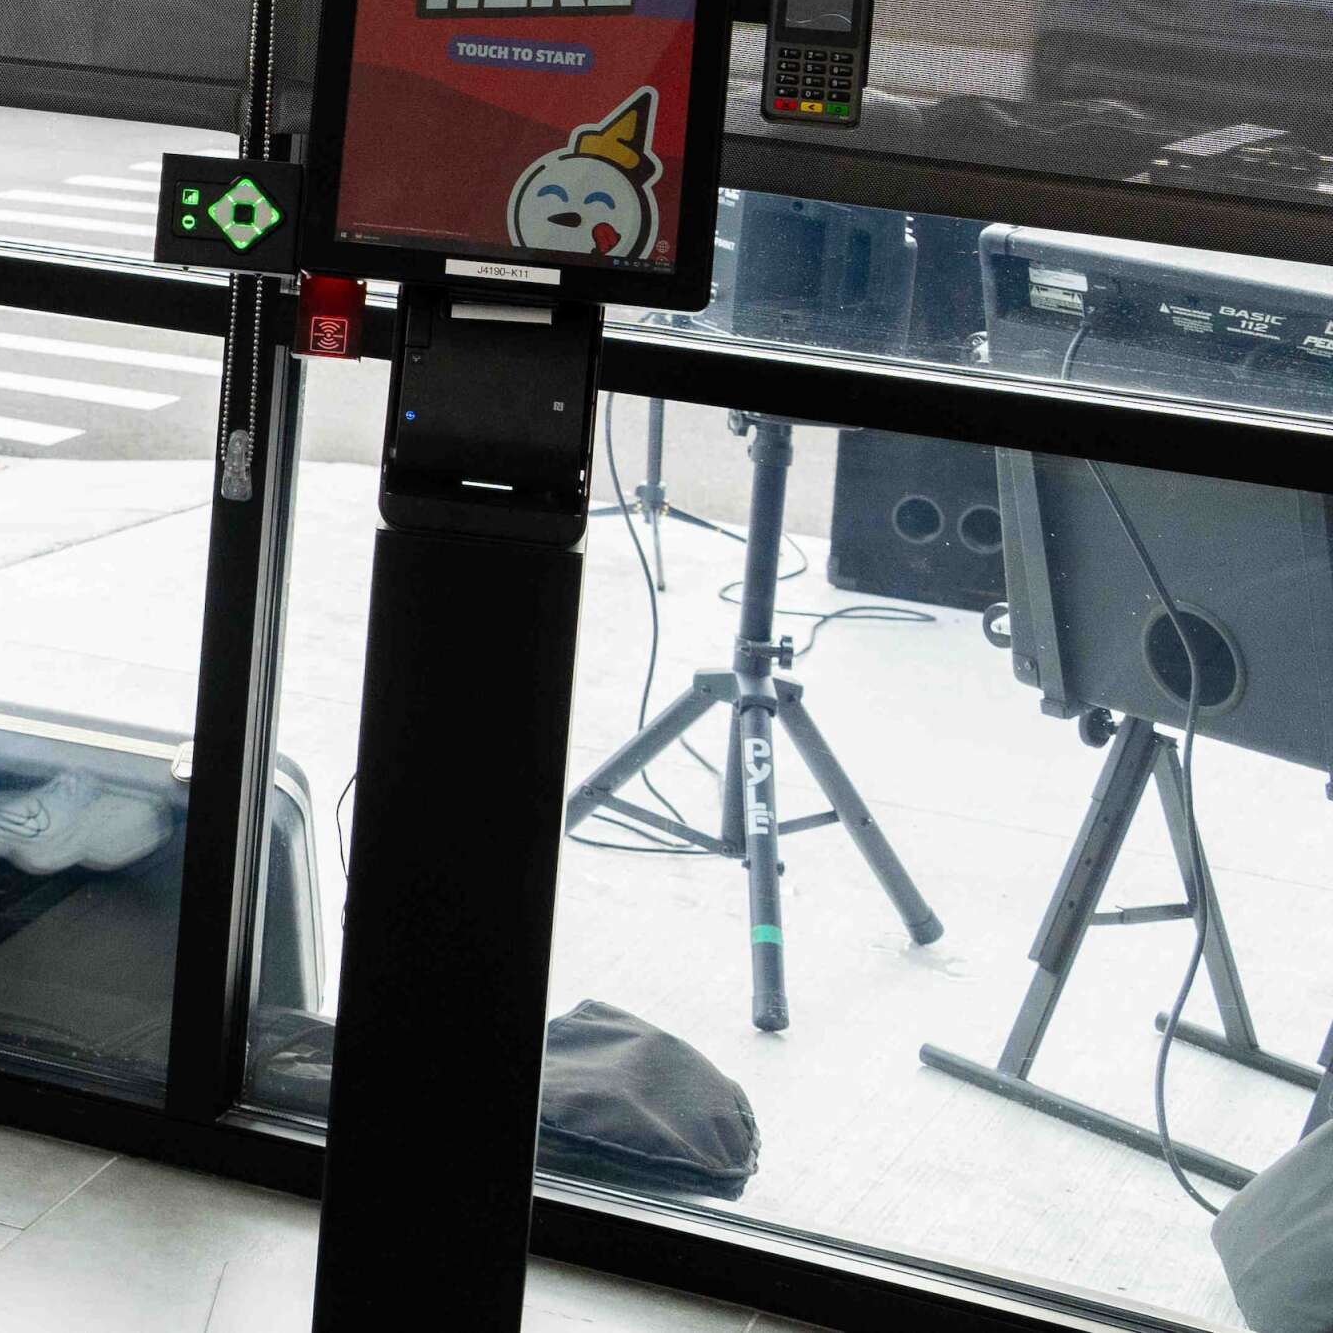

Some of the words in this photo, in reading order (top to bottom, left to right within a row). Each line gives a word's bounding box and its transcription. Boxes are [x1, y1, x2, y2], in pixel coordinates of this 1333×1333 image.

[457, 42, 509, 59] TOUCH
[512, 47, 533, 61] TO
[536, 49, 586, 66] START
[1219, 305, 1287, 325] BASIC
[1239, 319, 1269, 333] 112
[744, 738, 773, 836] PYLE
